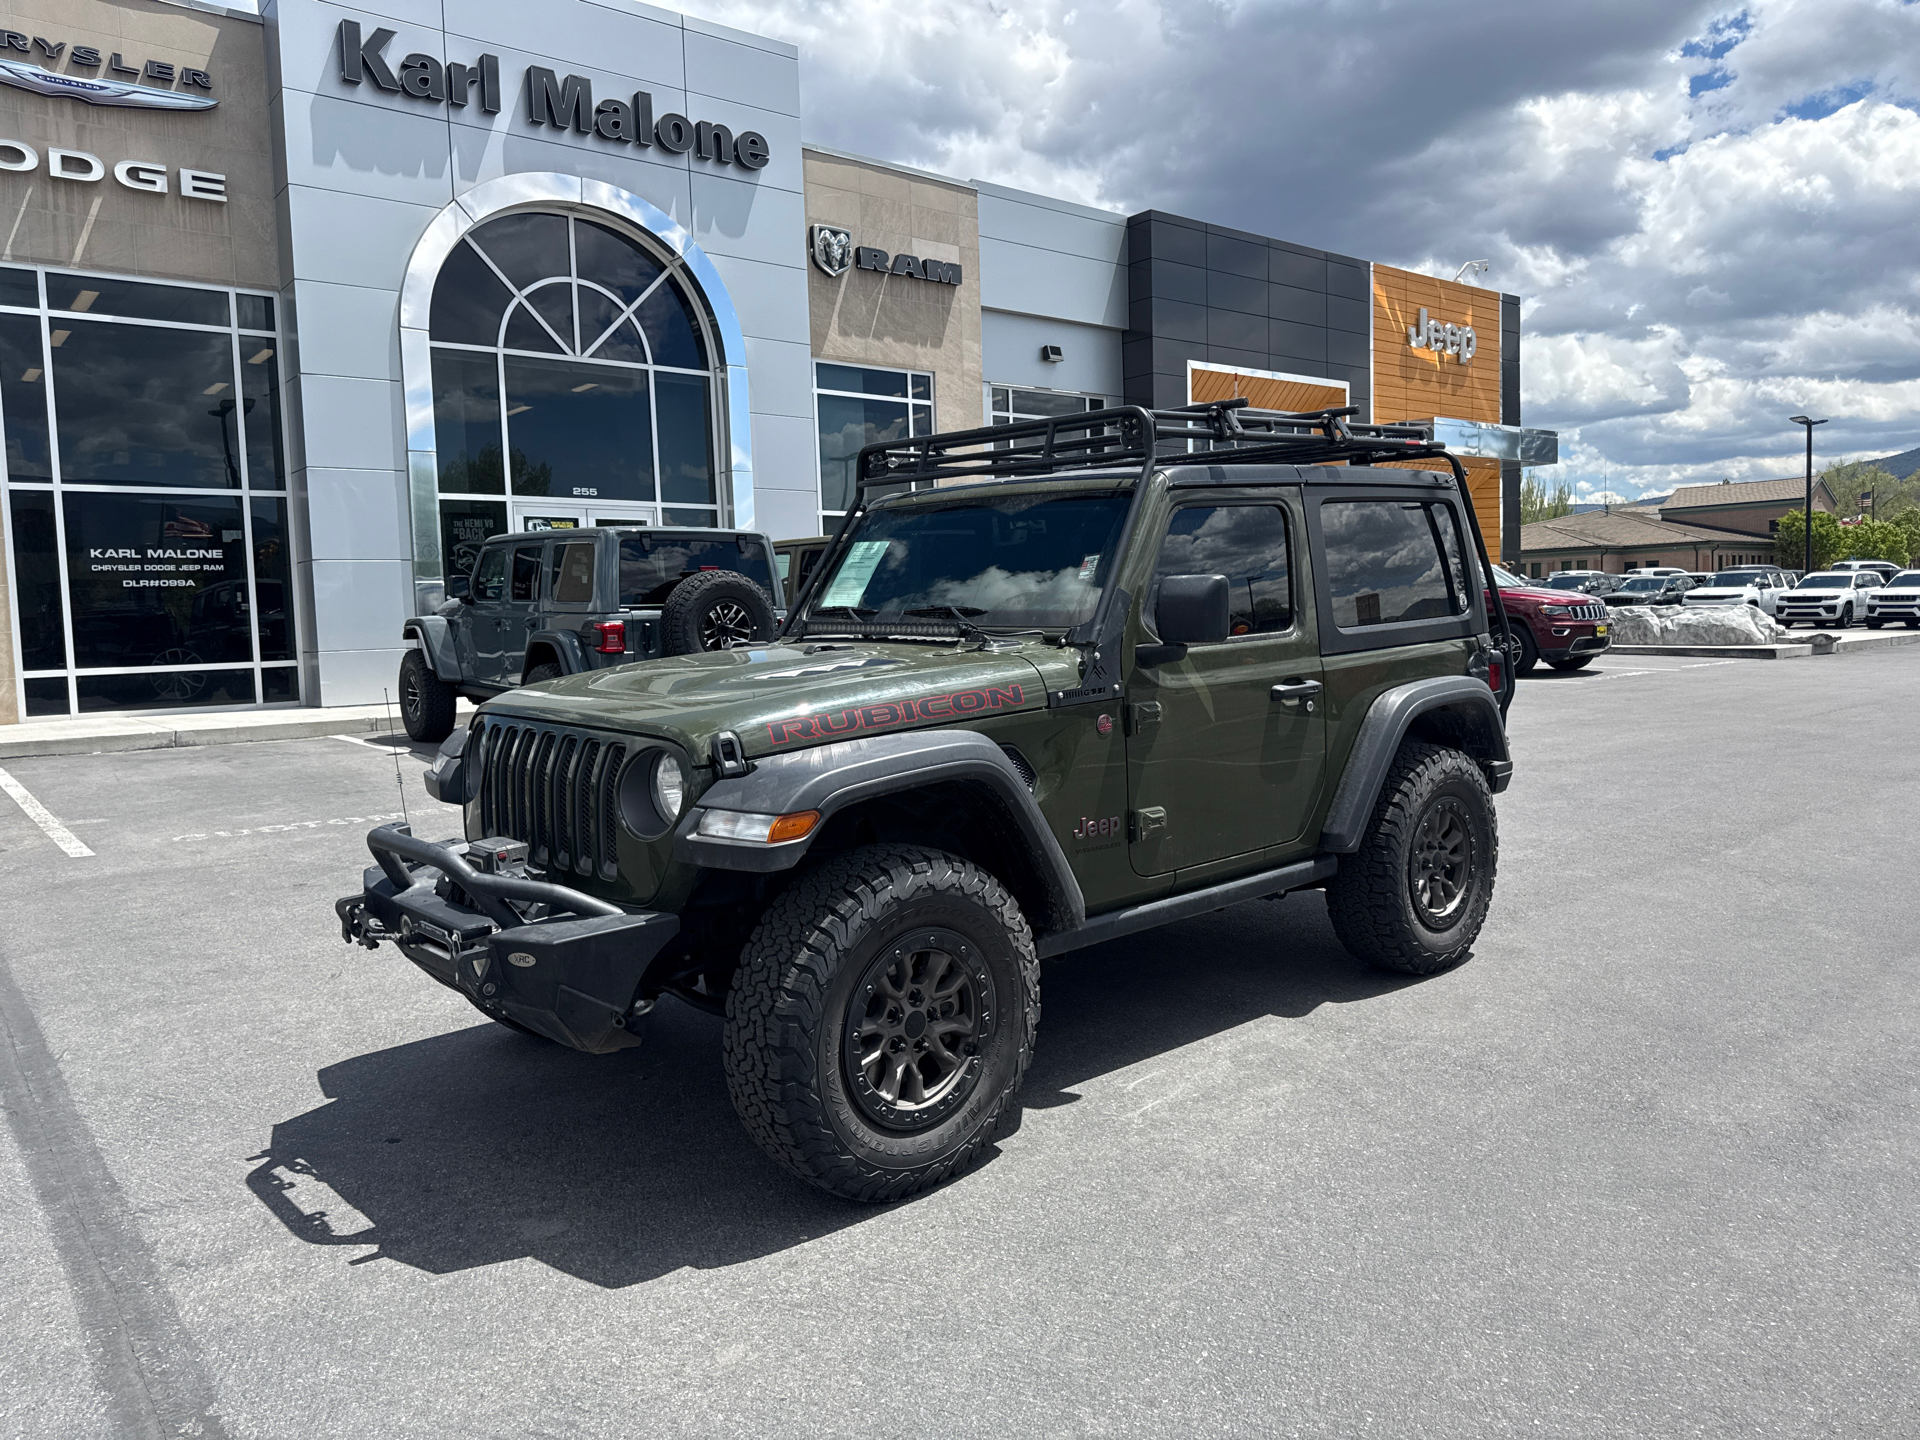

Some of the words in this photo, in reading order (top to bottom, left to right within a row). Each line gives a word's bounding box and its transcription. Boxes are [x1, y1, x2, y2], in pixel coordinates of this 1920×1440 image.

[38, 75, 100, 90] CHRYSLER
[338, 18, 501, 115] Karl
[527, 64, 770, 171] Malone
[855, 246, 962, 286] RAM
[1408, 307, 1477, 365] Jeep
[572, 487, 598, 496] 255
[453, 520, 464, 528] THE
[464, 518, 483, 528] HEMI
[484, 518, 494, 528] V8
[459, 527, 486, 540] BACK
[90, 548, 142, 559] KARL
[147, 549, 224, 559] MALONE
[122, 579, 196, 588] DLR#099A
[767, 684, 1025, 745] RUBICON
[1073, 816, 1121, 840] Jeep
[1075, 841, 1122, 855] WRANGLER
[513, 955, 530, 964] XRC
